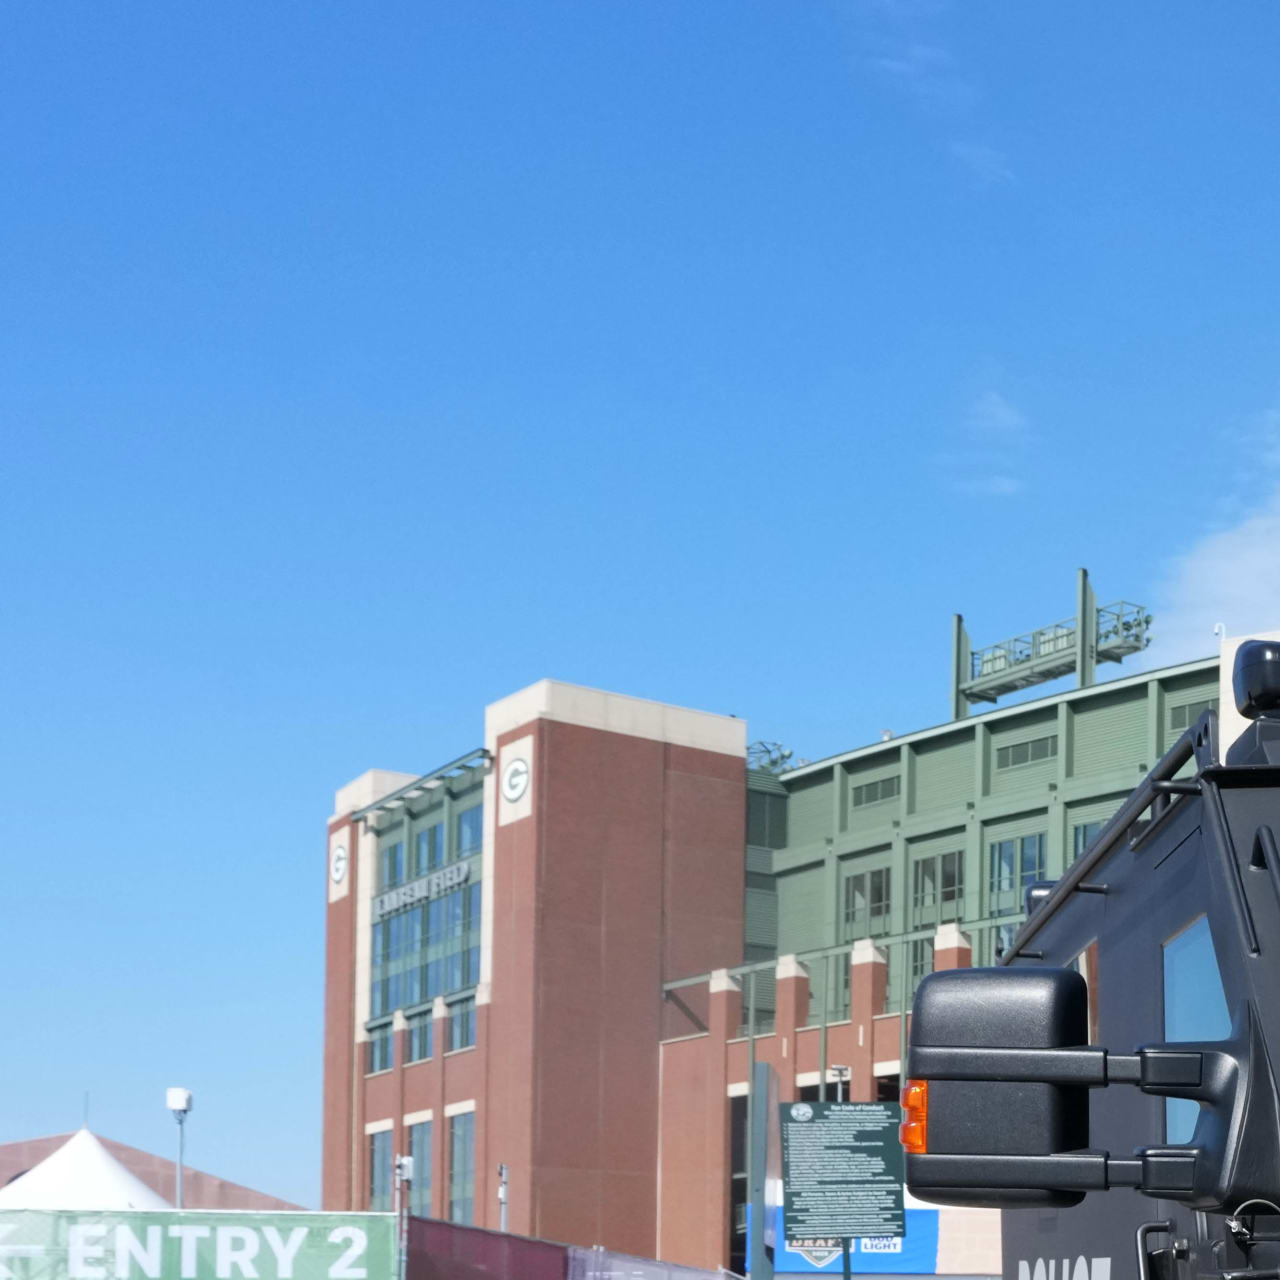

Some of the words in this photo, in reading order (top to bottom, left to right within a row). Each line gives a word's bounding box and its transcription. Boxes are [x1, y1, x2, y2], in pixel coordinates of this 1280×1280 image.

[502, 757, 529, 804] G
[67, 1225, 309, 1279] ENTRY
[327, 1226, 367, 1279] 2
[864, 1242, 898, 1250] LIGHT
